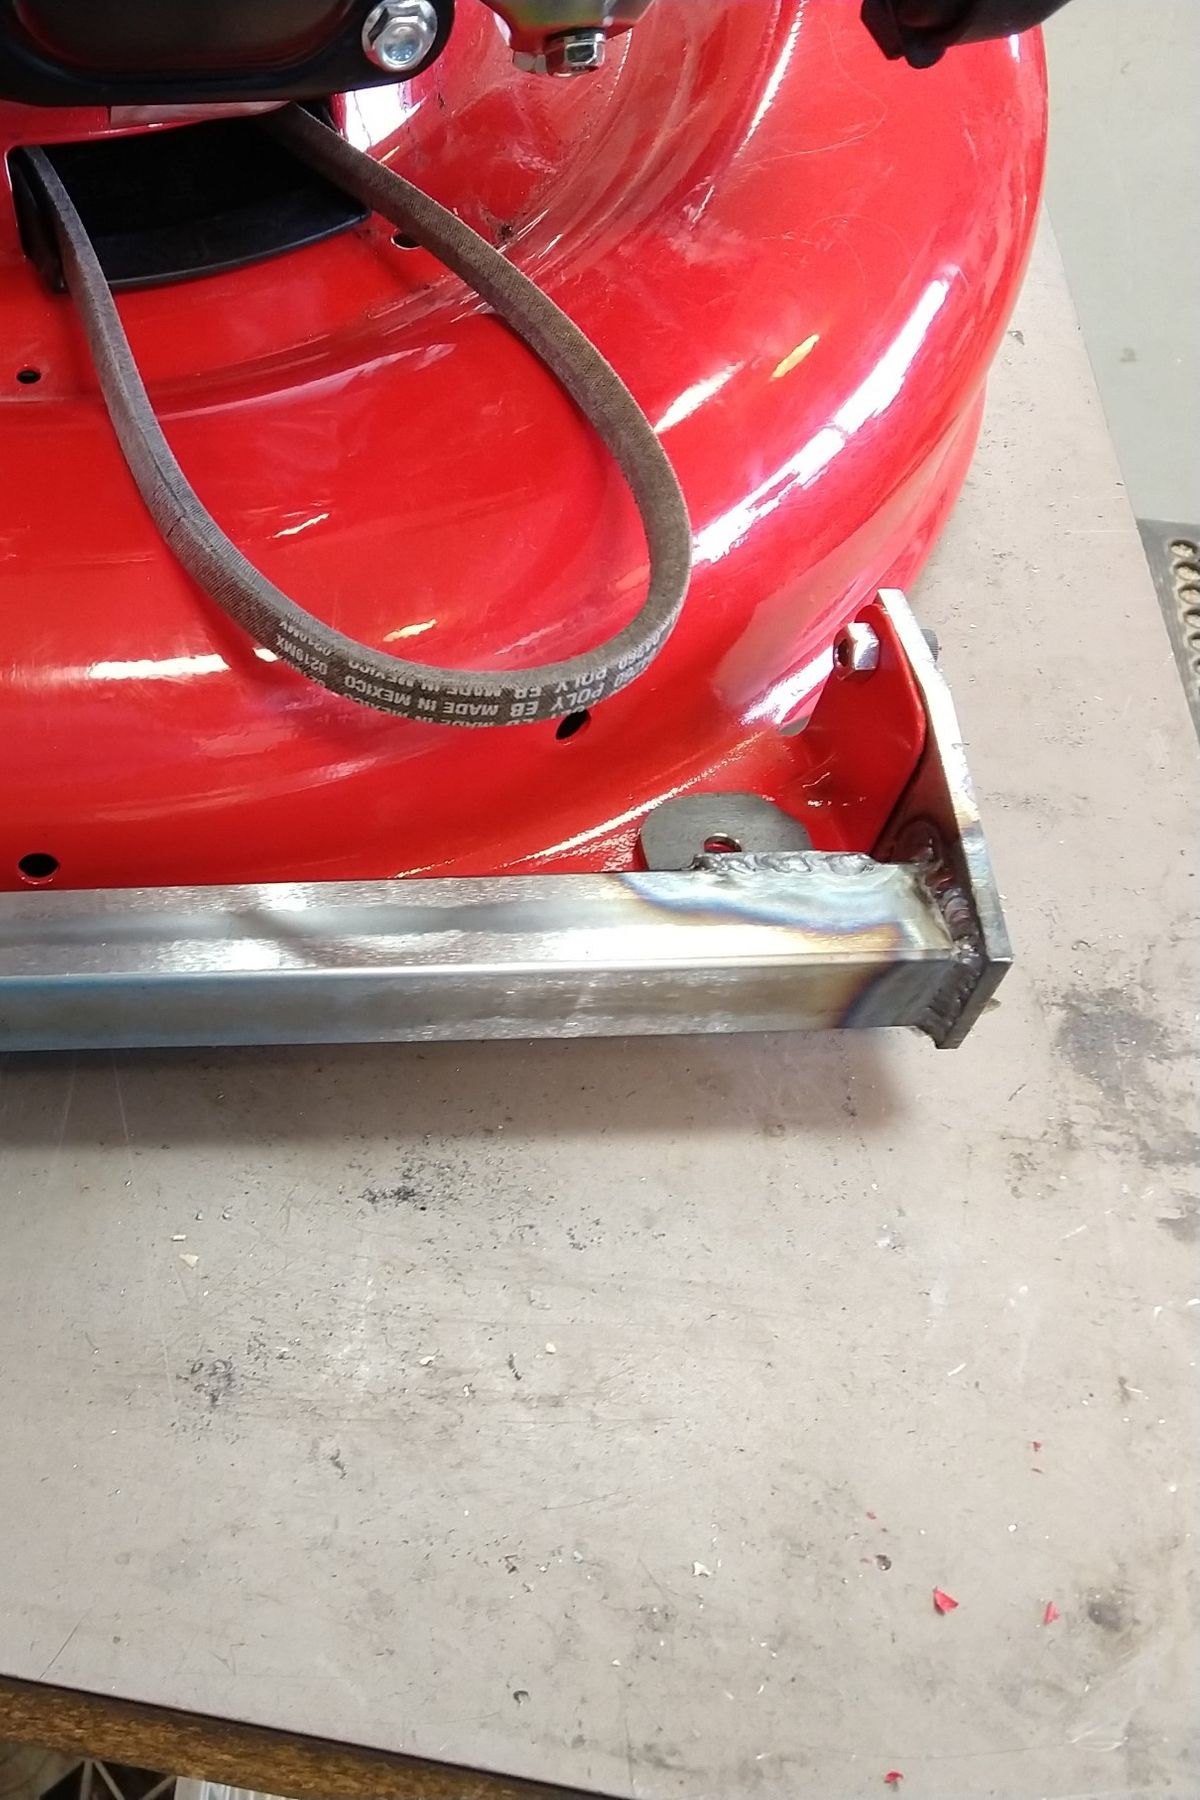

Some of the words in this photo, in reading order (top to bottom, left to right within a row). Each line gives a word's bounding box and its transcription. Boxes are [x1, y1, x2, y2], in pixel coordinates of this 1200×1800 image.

[344, 674, 412, 708] MEXICO
[550, 682, 605, 711] POLY
[417, 696, 437, 712] IN
[442, 700, 499, 717] MADE
[509, 700, 540, 718] EB
